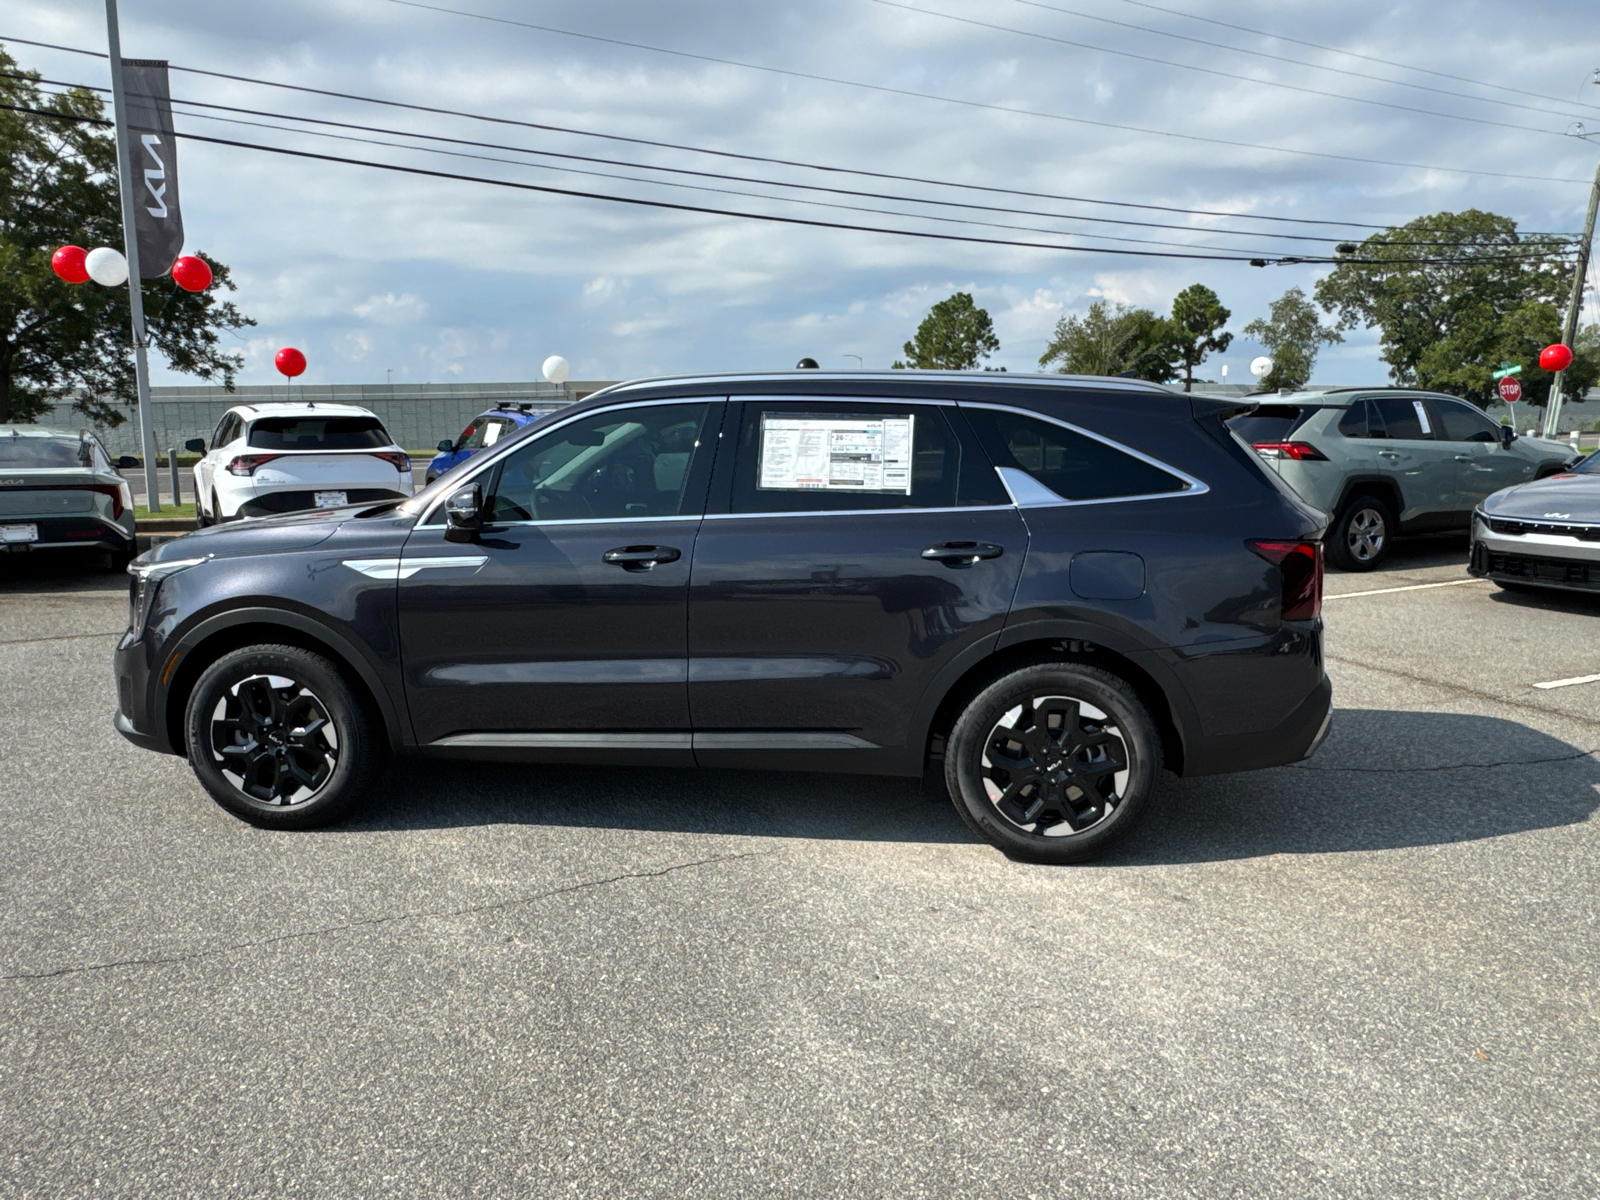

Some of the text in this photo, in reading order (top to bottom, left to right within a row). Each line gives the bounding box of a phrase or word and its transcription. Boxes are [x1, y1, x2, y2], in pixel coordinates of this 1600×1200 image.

[140, 134, 168, 218] KIA
[1501, 384, 1519, 395] STOP
[268, 732, 284, 746] KIA
[1046, 759, 1063, 772] KIA
